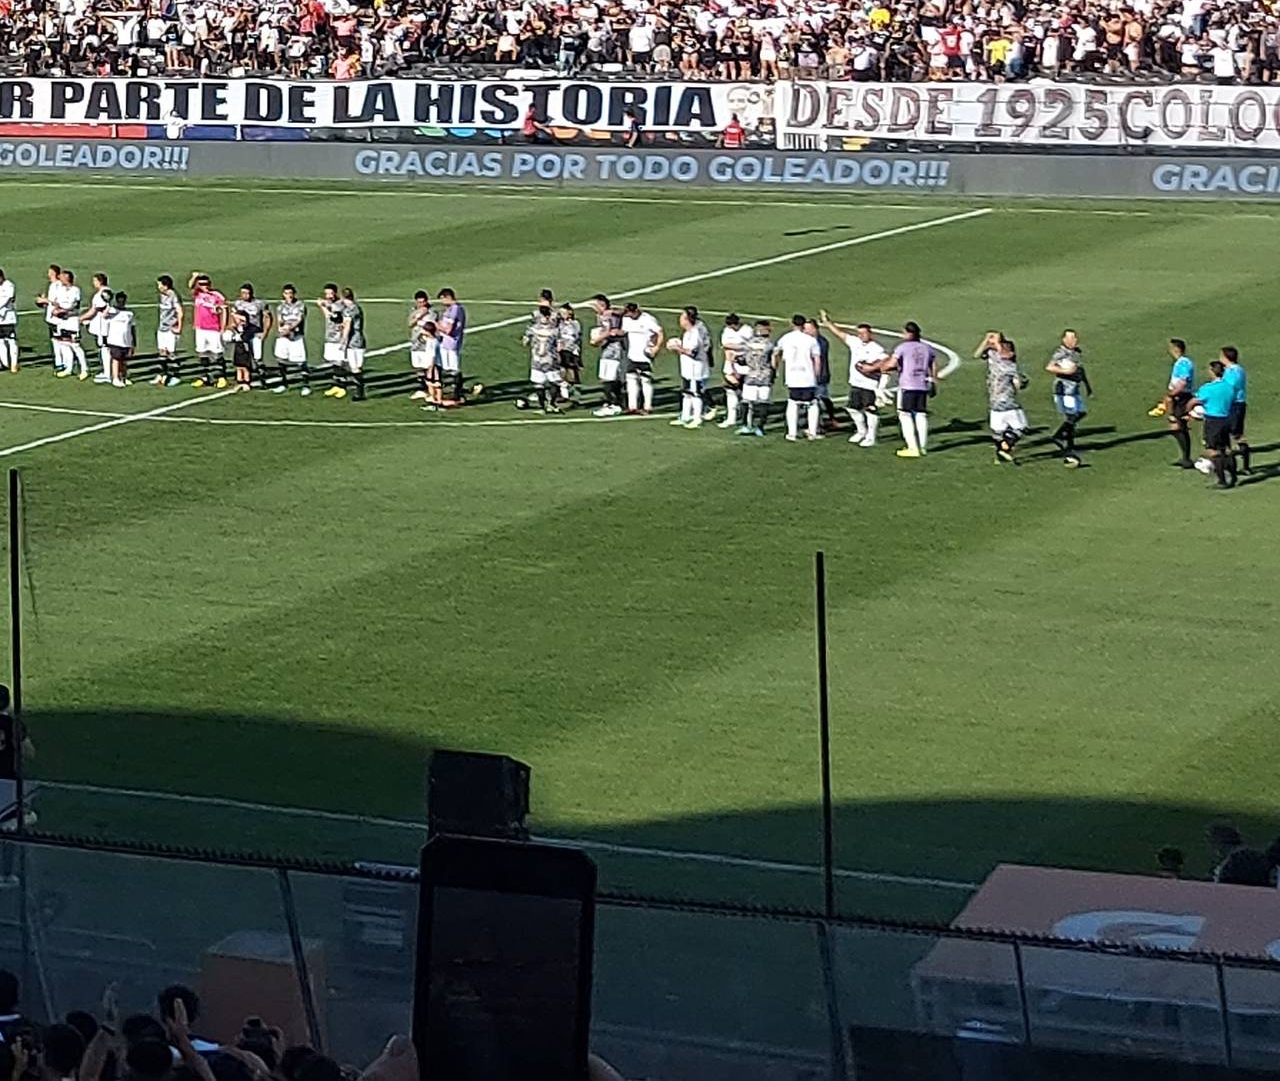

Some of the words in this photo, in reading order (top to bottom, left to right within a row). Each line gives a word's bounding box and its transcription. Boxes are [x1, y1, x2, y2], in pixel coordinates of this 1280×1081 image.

[50, 81, 229, 122] PARTE
[243, 83, 317, 124] DE
[333, 84, 400, 125] LA
[414, 83, 717, 127] HISTORIA
[790, 83, 953, 135] DESDE
[354, 149, 502, 178] GRACIAS
[511, 152, 587, 180] POR
[596, 154, 698, 183] TODO
[708, 156, 950, 187] GOLEADOR!!!
[1152, 163, 1280, 194] GRACI
